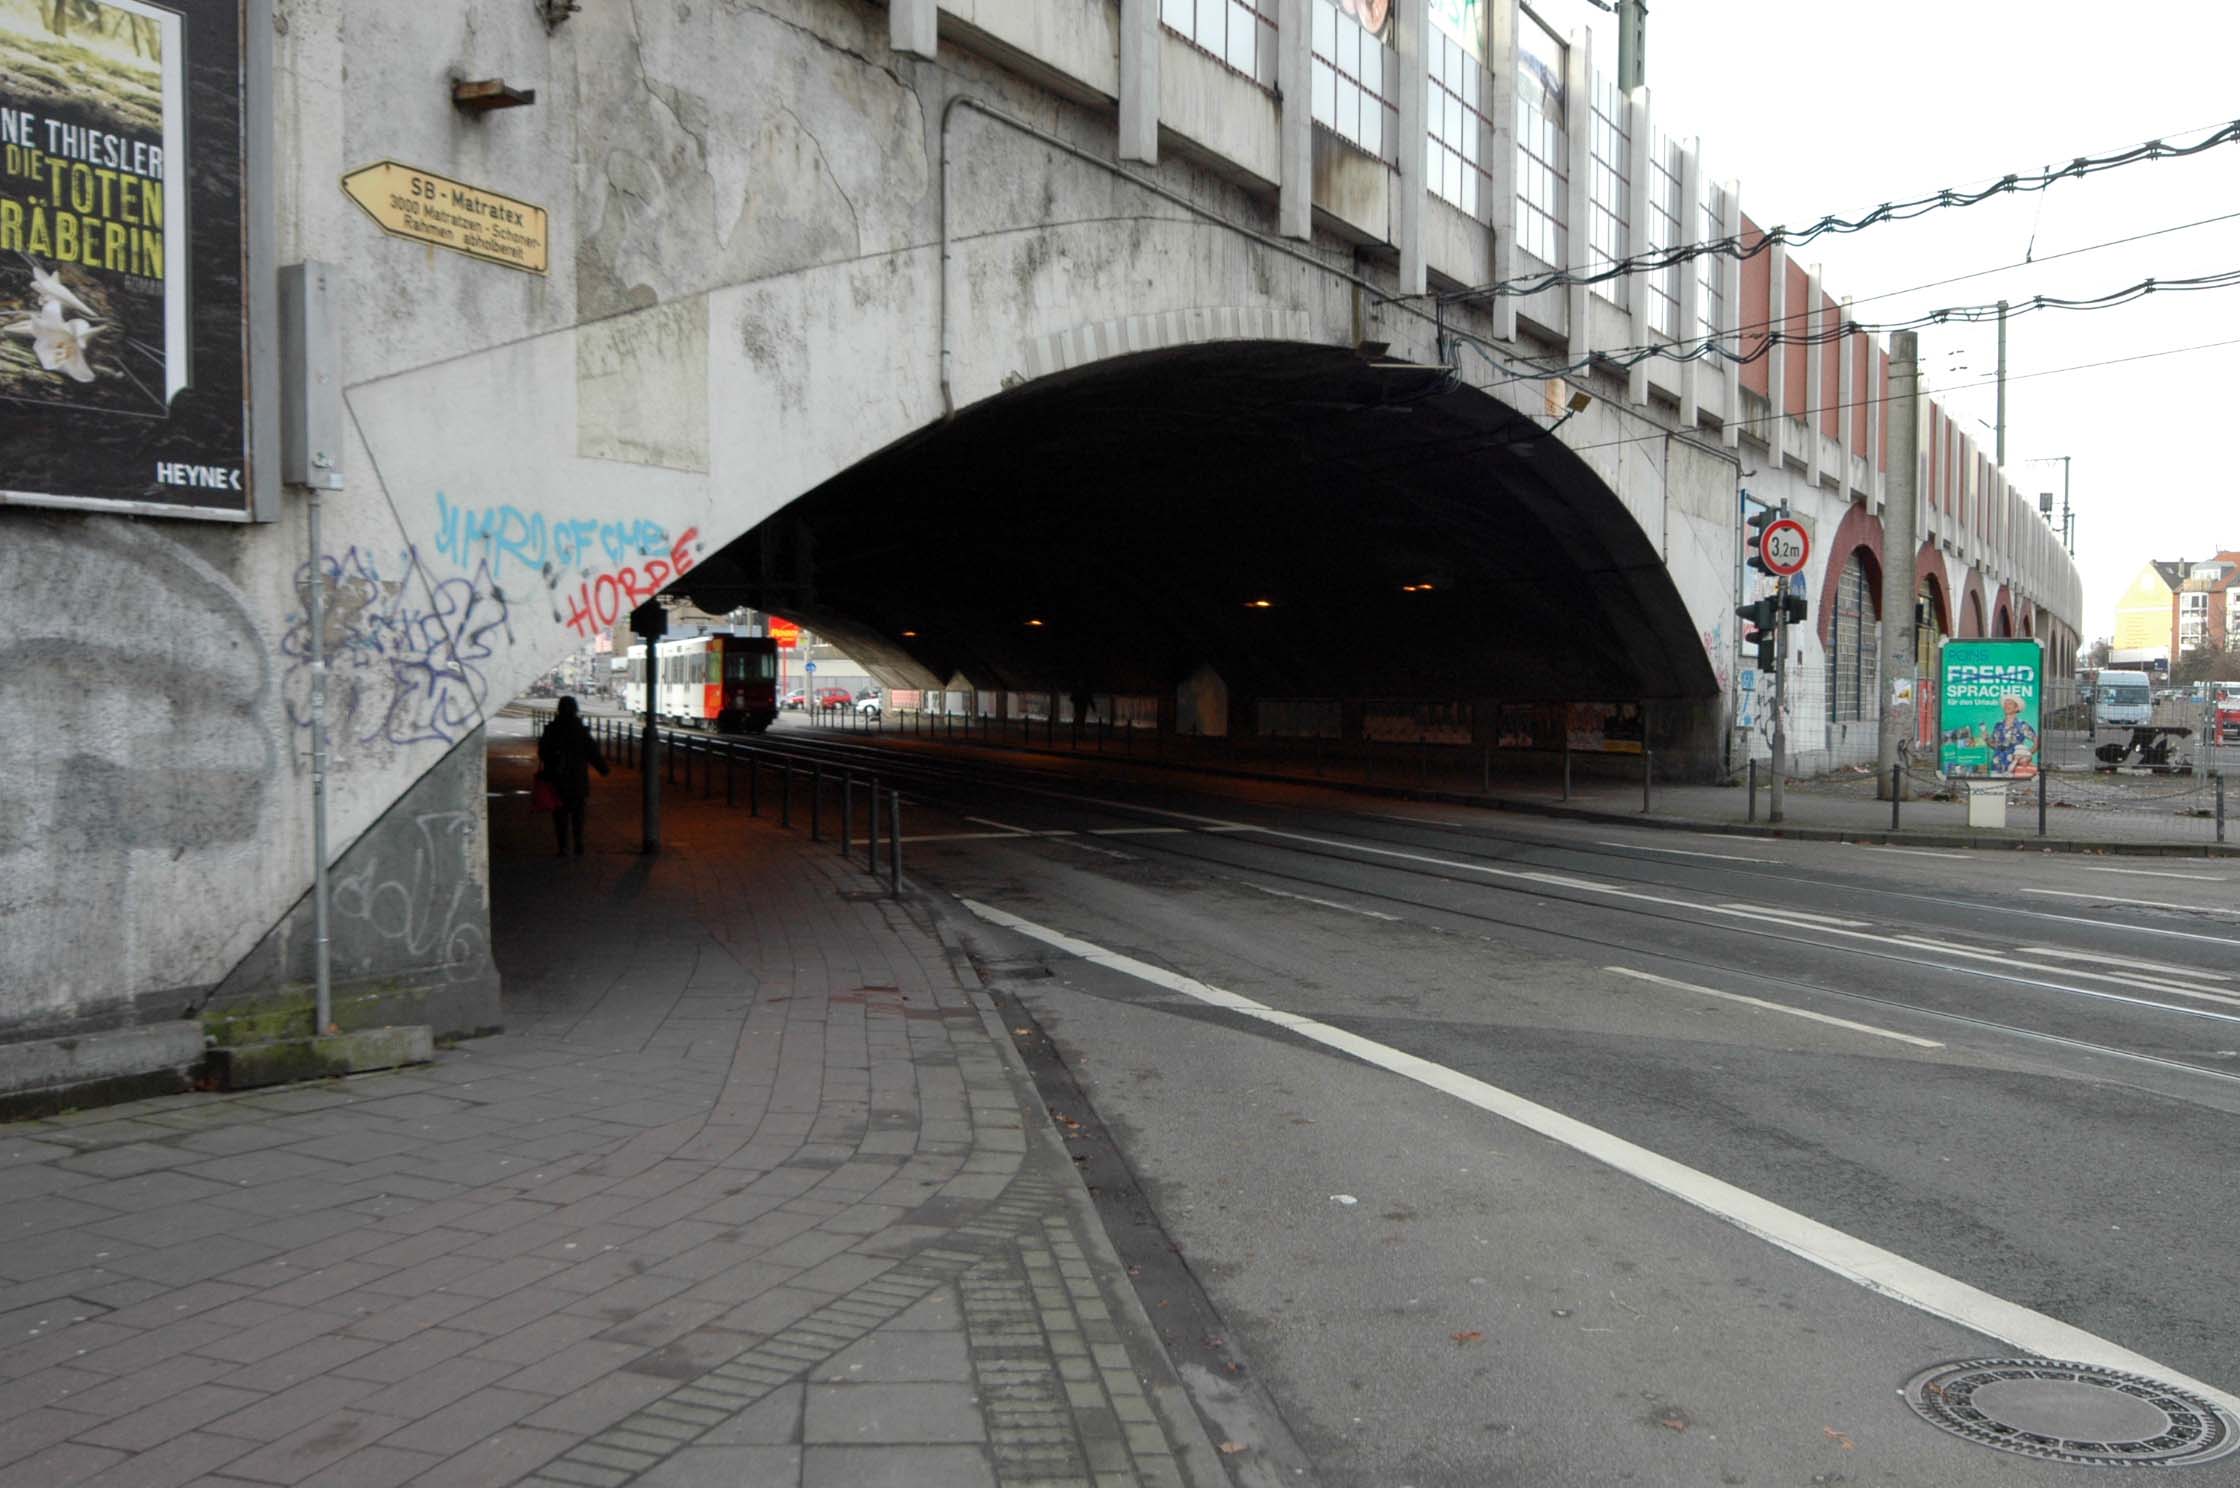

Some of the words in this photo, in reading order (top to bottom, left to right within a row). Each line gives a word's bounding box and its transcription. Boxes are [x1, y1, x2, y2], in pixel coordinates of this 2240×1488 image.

[6, 144, 43, 182] DIE
[44, 118, 162, 179] THIESLER
[44, 156, 163, 229] TOTEN
[411, 177, 436, 200] SB
[451, 189, 524, 227] Matratex
[423, 204, 482, 233] Matratzen
[1947, 665, 2034, 684] FREMD
[1947, 684, 2033, 698] SPRACHEN
